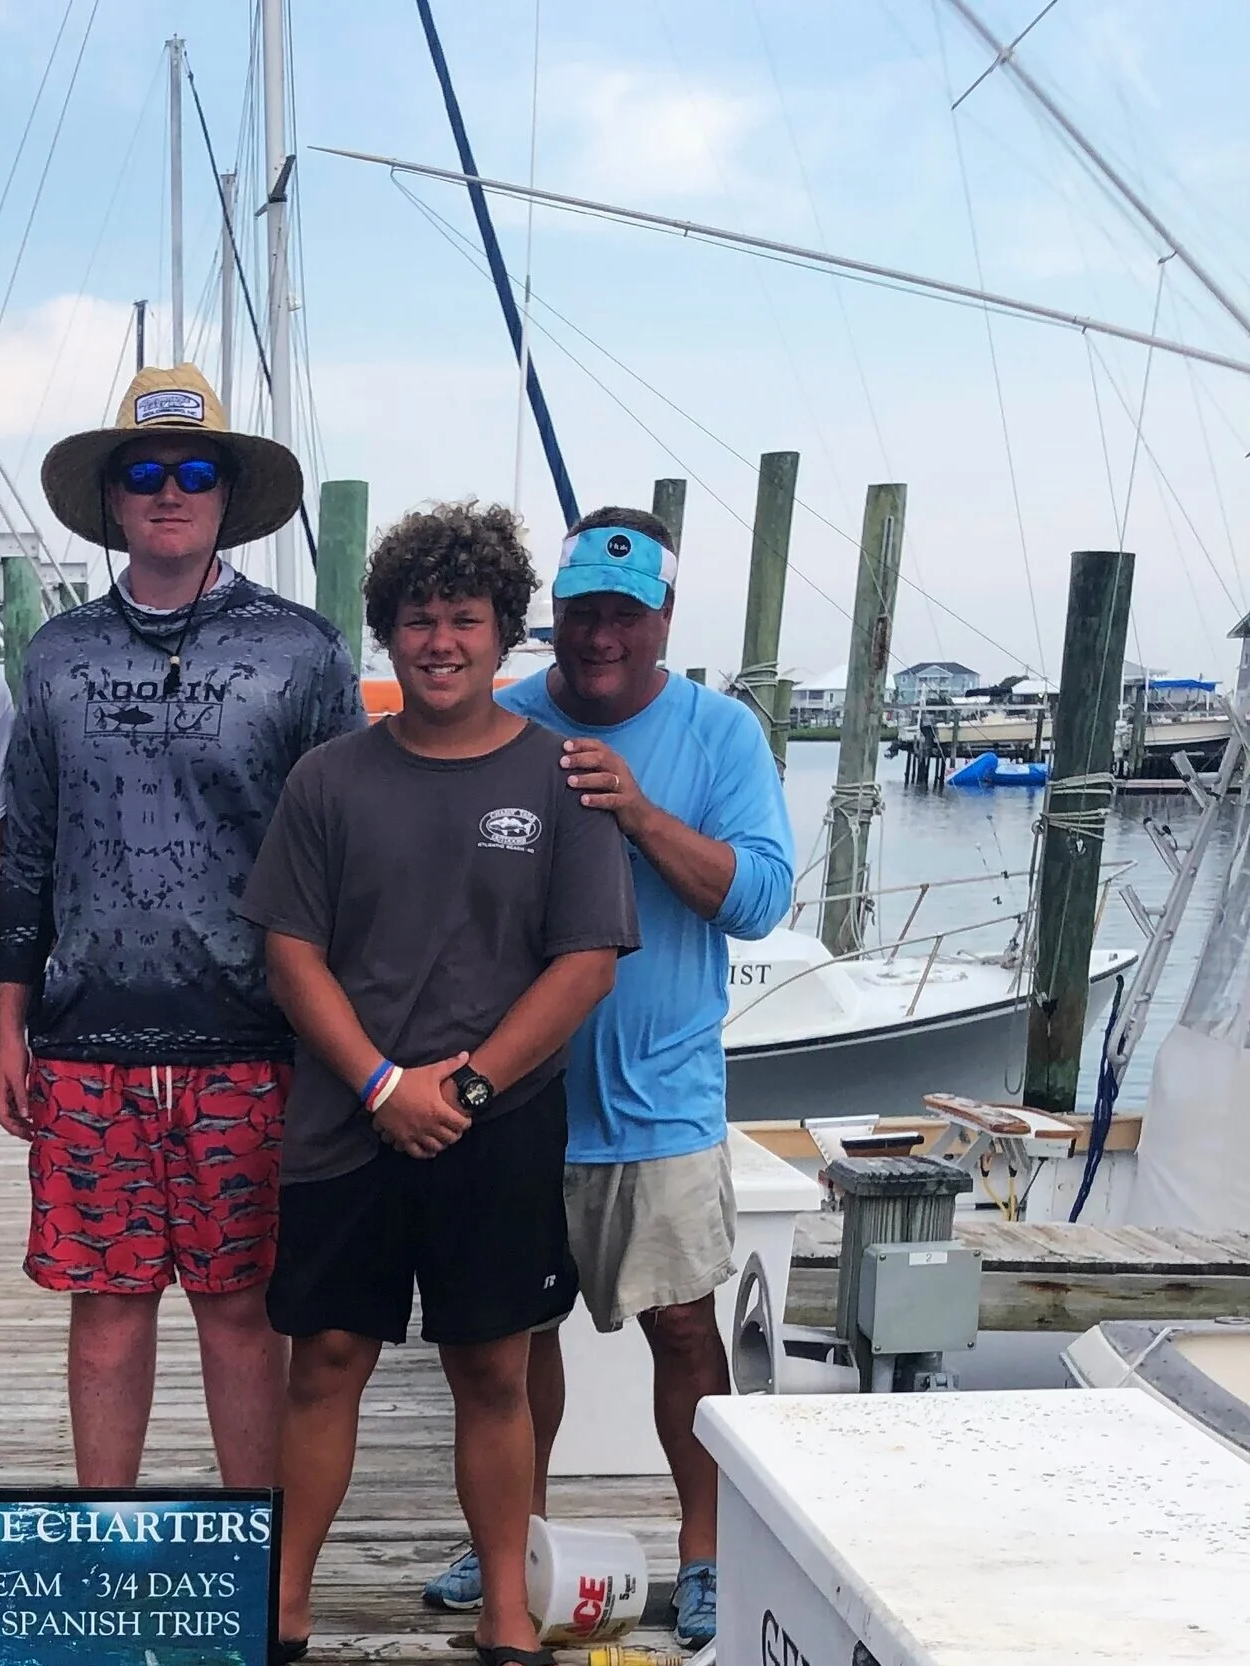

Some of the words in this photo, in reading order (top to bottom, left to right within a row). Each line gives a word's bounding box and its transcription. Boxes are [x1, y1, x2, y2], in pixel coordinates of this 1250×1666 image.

[729, 964, 772, 986] IST
[925, 1253, 932, 1263] 2
[36, 1510, 271, 1544] CHARTERS
[96, 1572, 138, 1600] 3/4
[148, 1572, 235, 1598] DAYS
[1, 1611, 141, 1636] SPANISH
[149, 1611, 240, 1637] TRIPS
